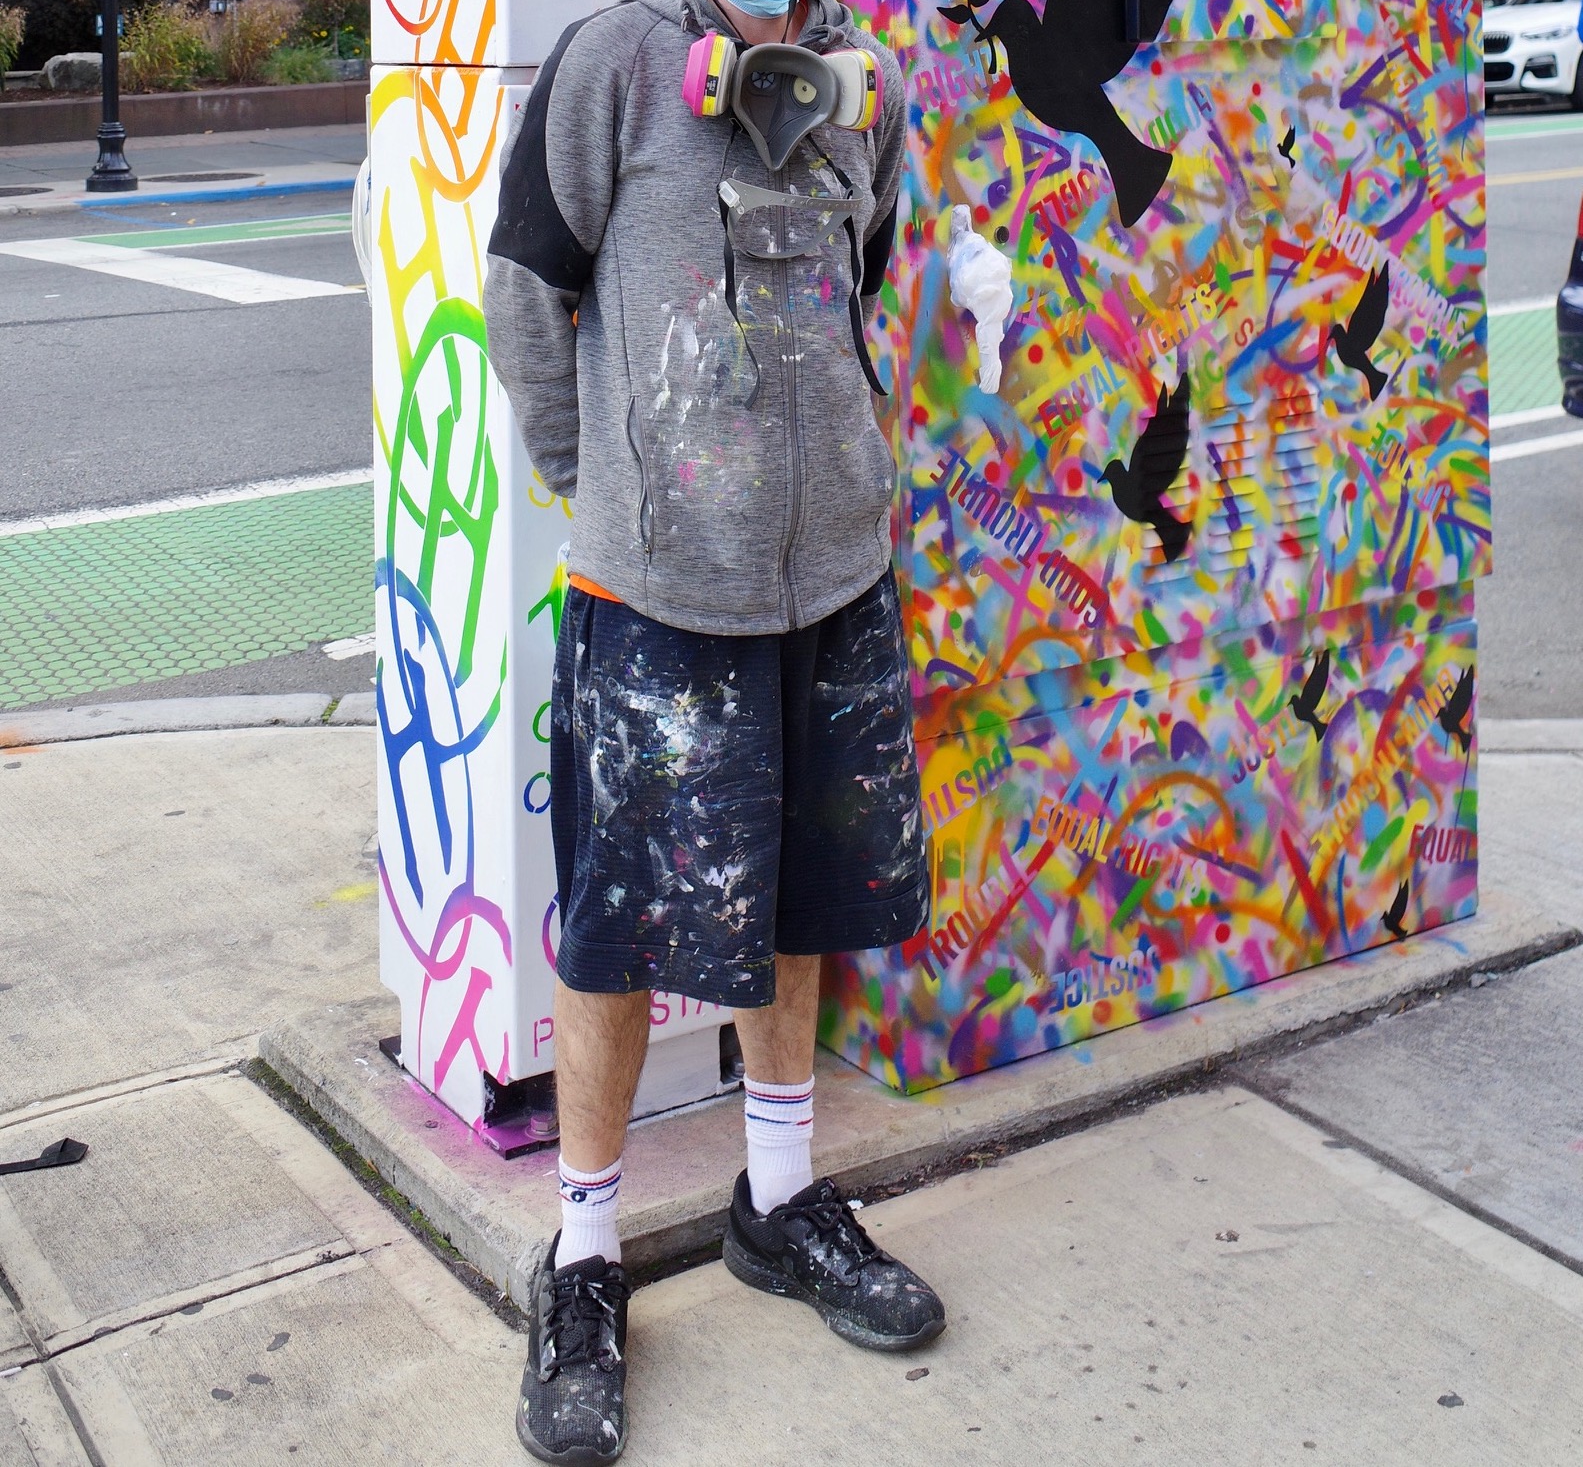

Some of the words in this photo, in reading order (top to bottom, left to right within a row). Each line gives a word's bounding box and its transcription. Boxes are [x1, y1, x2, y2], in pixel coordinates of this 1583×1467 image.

[1038, 355, 1127, 439] EQUAL
[1125, 283, 1218, 363] RIGHTS
[929, 446, 1043, 569] TROUBLE
[1037, 549, 1110, 630] GOOD
[922, 745, 1010, 840] JUSTIC
[1031, 797, 1112, 864] EQUAL
[1049, 944, 1162, 1014] JUSTICE
